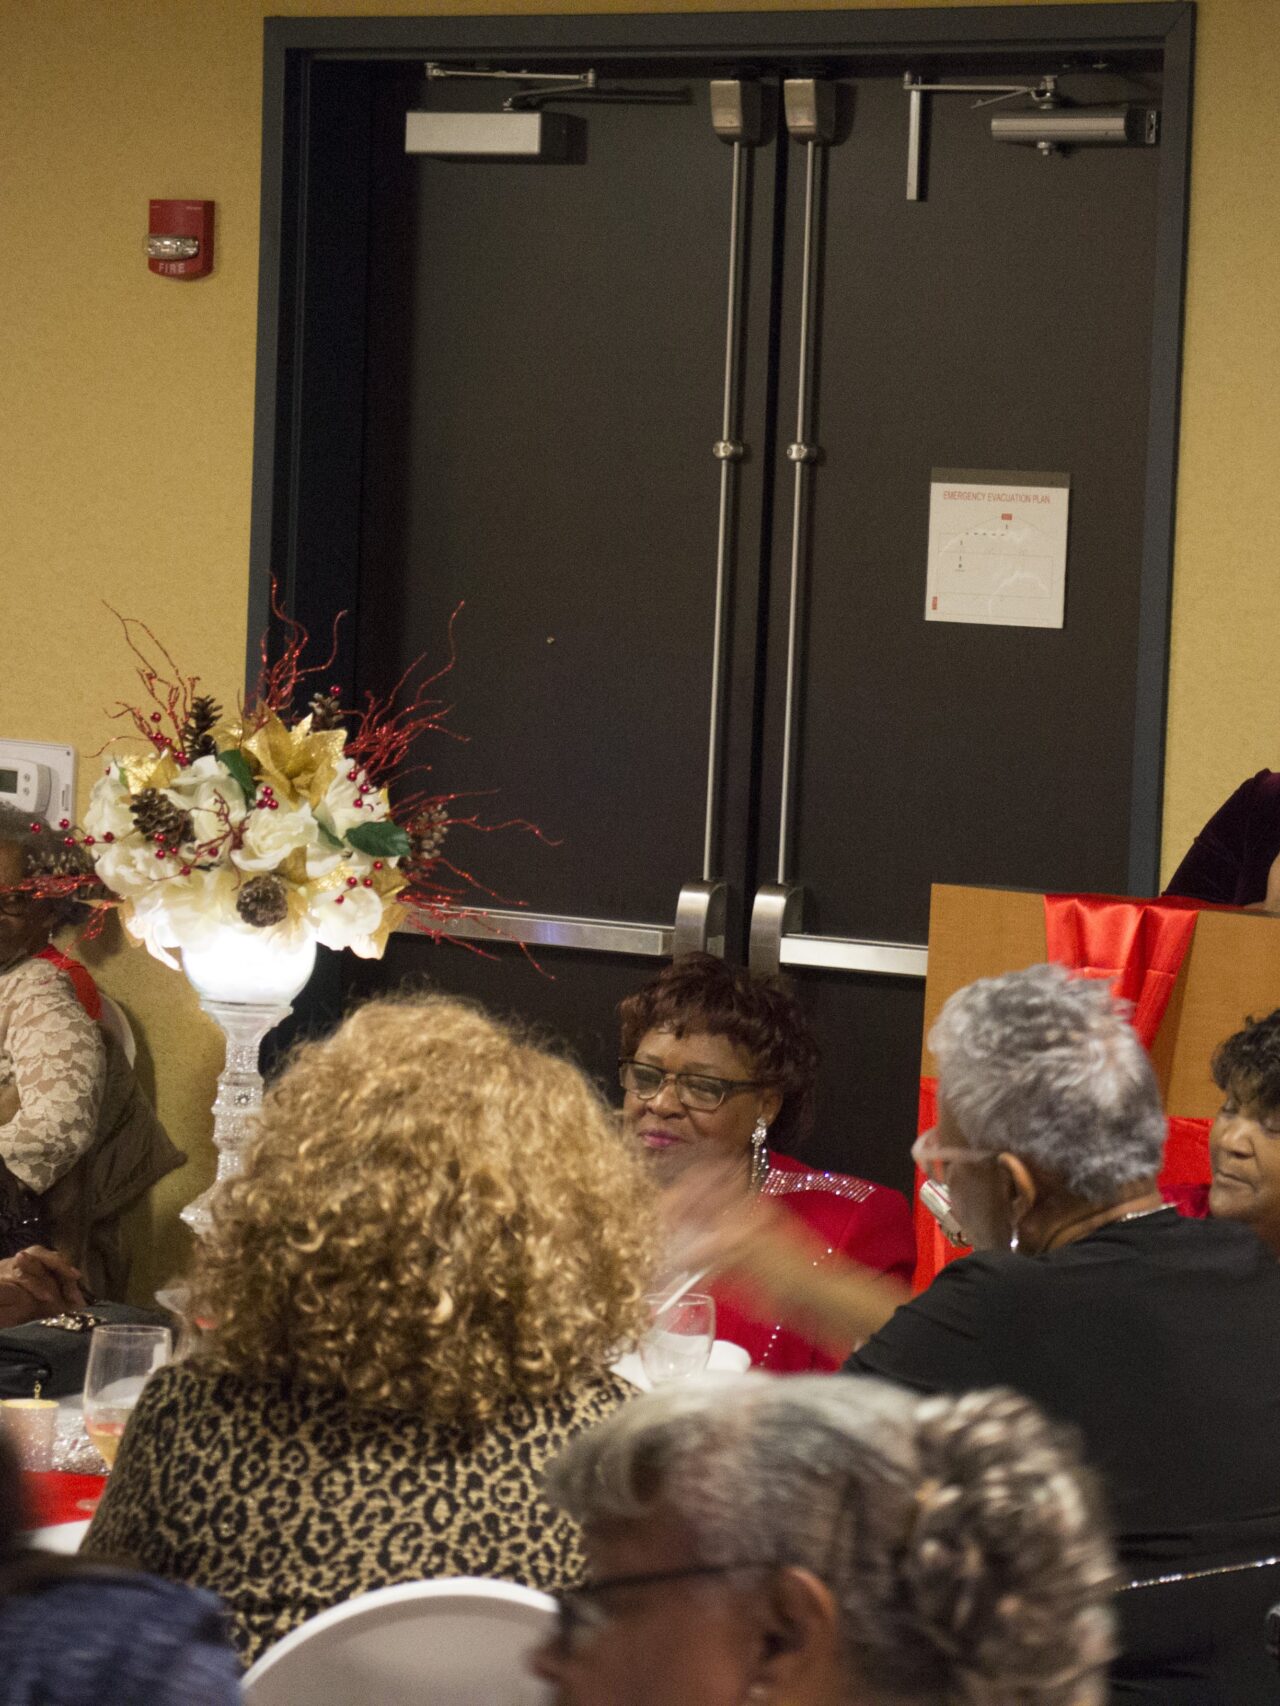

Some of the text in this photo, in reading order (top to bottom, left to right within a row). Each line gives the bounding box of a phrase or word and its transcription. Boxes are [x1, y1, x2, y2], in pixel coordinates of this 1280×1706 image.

[158, 262, 185, 274] FIRE
[943, 490, 1051, 504] EMERGENCY EVACUATION PLAN
